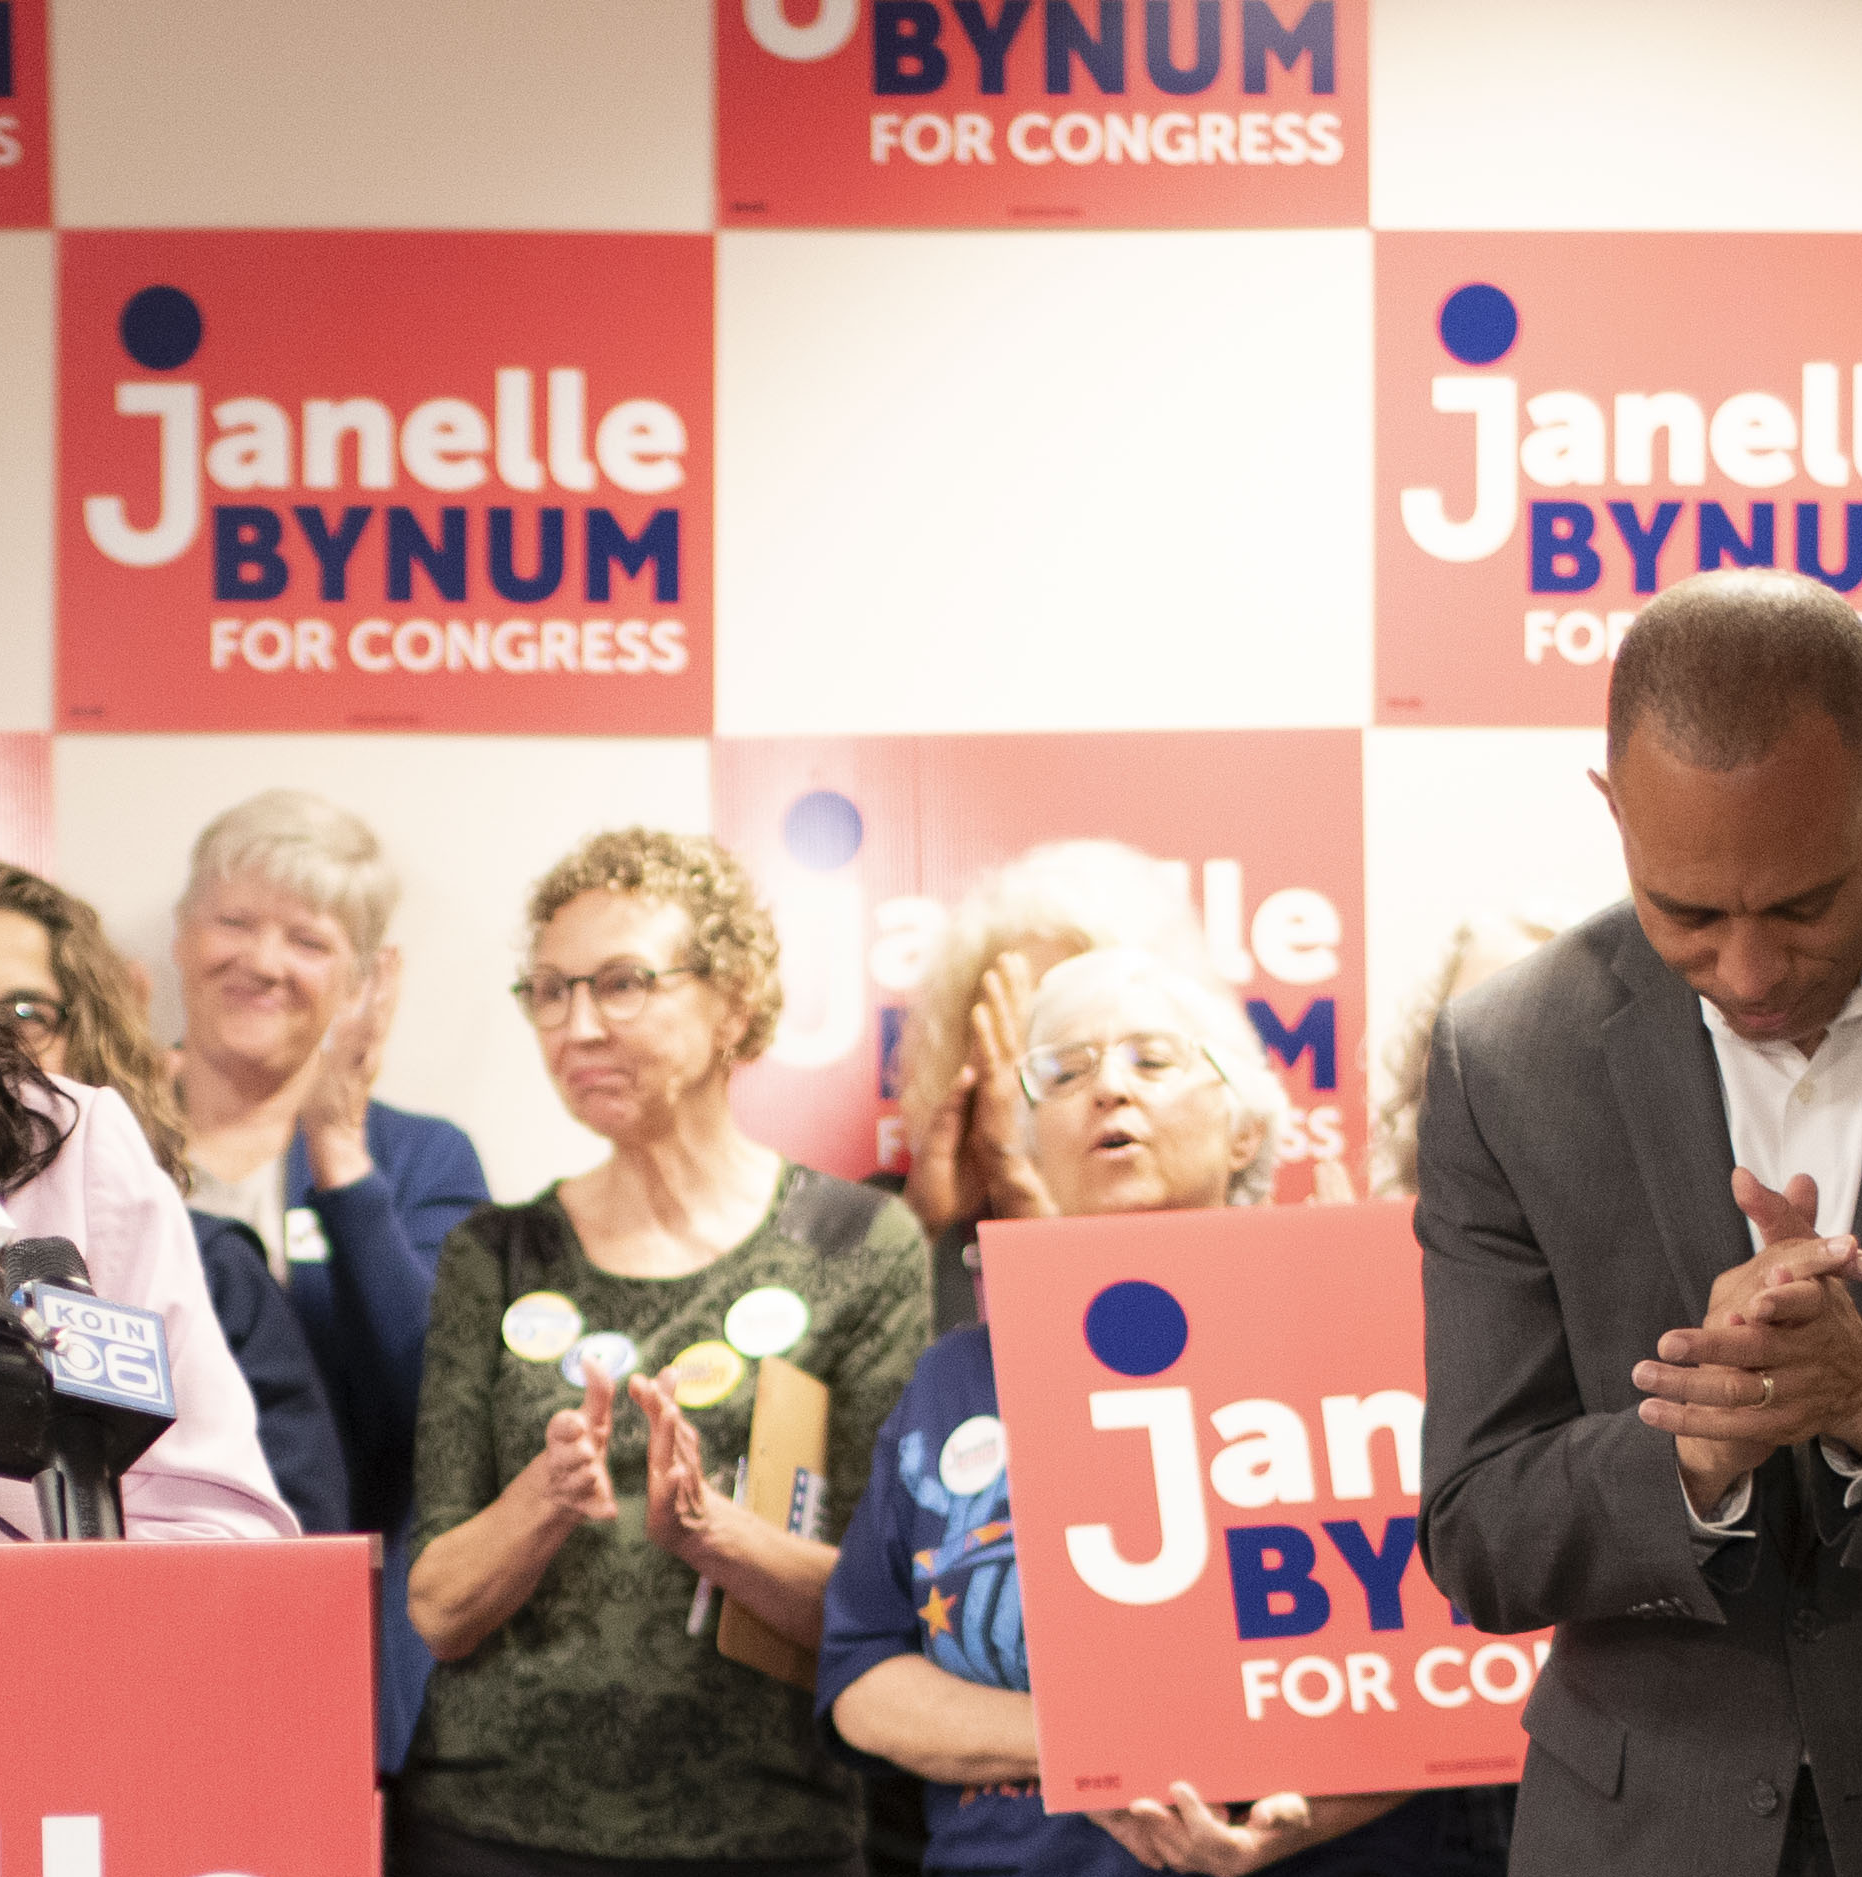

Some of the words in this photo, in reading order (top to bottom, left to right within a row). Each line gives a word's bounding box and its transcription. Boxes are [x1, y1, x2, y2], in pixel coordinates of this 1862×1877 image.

[873, 0, 1337, 98] BYNUM
[870, 112, 995, 166] FOR
[1006, 112, 1344, 166] CONGRESS
[210, 503, 681, 604] BYNUM
[210, 620, 335, 674] FOR
[345, 617, 688, 674] CONGRESS
[55, 1303, 147, 1343] KOIN
[104, 1342, 159, 1395] 6
[1240, 1652, 1399, 1721] FOR
